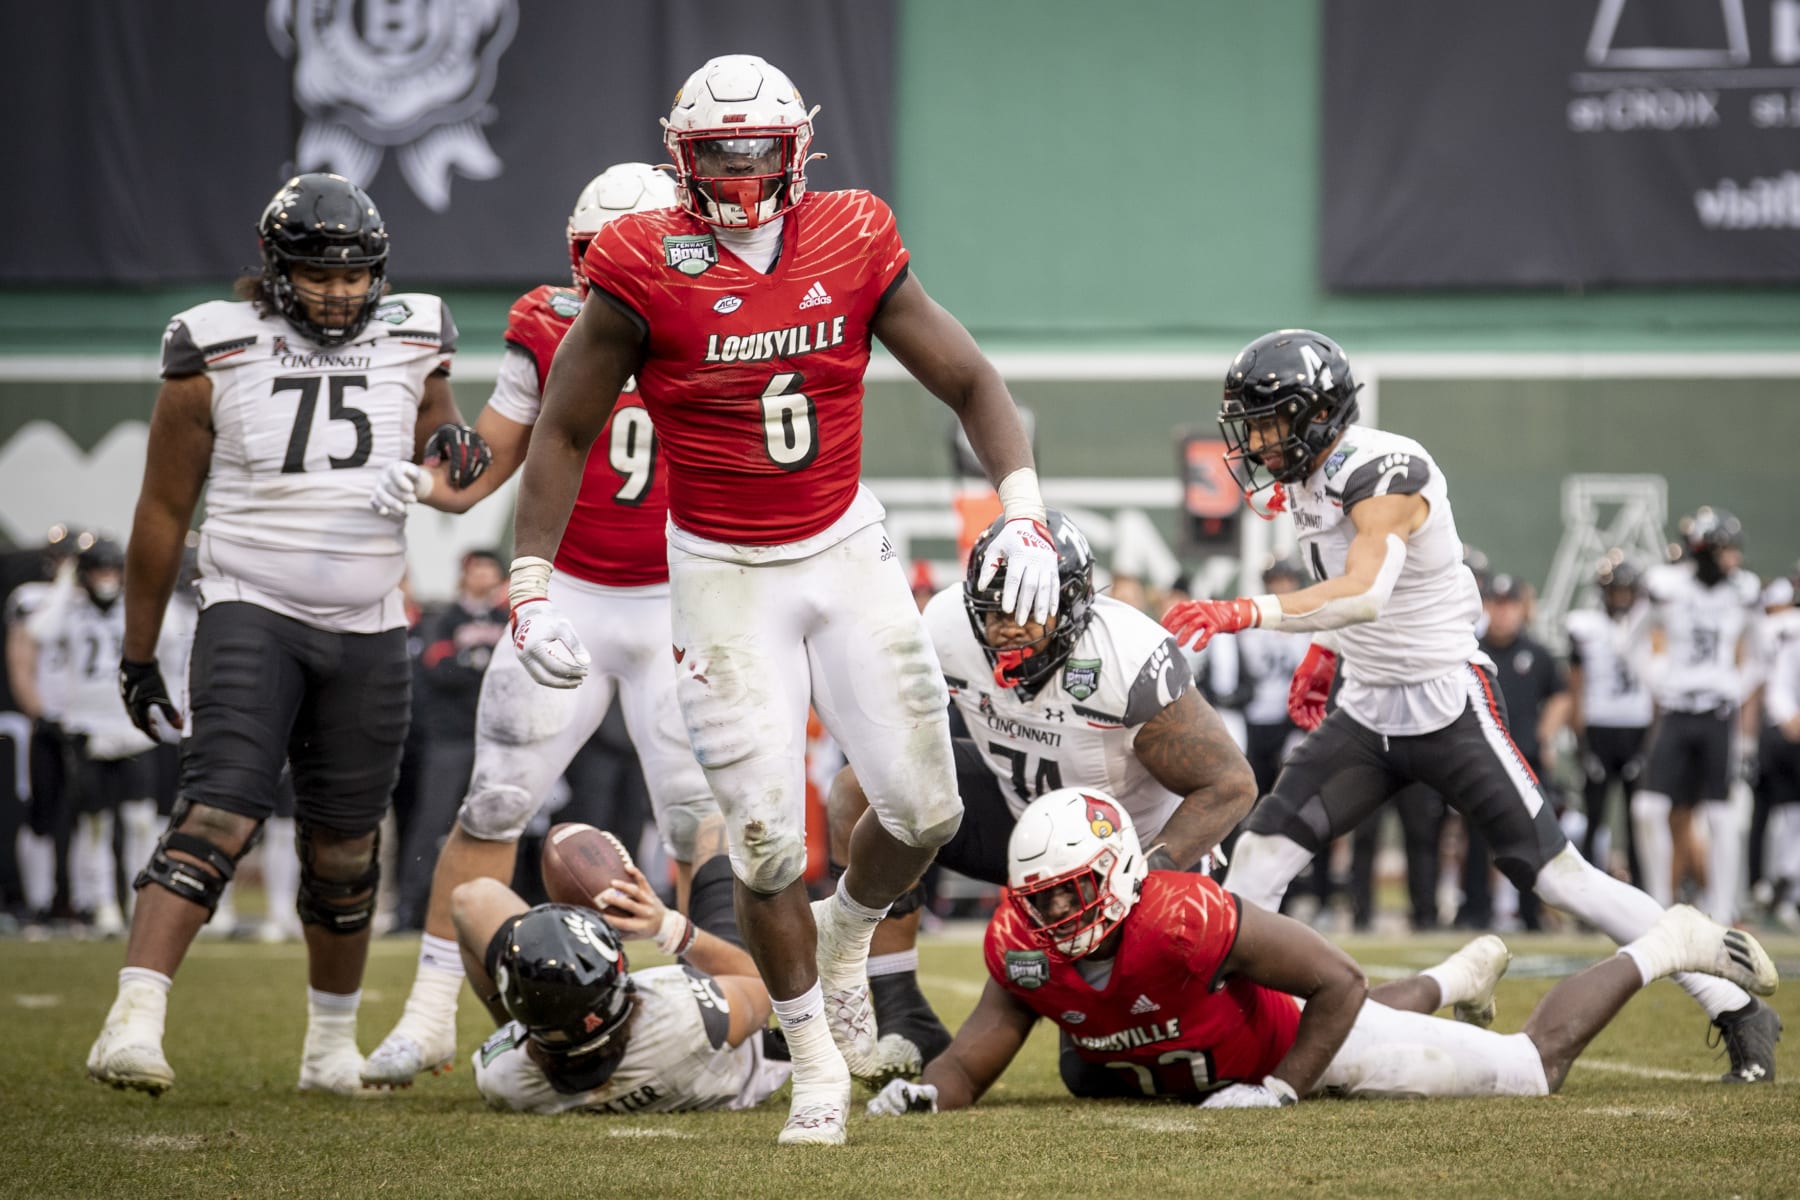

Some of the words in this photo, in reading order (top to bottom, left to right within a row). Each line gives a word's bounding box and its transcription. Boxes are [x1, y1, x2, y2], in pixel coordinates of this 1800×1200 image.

[669, 246, 715, 267] BOWL
[718, 298, 739, 310] ACC
[799, 294, 832, 310] adidas
[704, 315, 846, 363] LOUISVILLE
[281, 354, 371, 369] CINCINNATI
[271, 374, 373, 474] 75
[760, 371, 818, 471] 6
[609, 405, 658, 506] 9
[987, 717, 1061, 748] CINCINNATI
